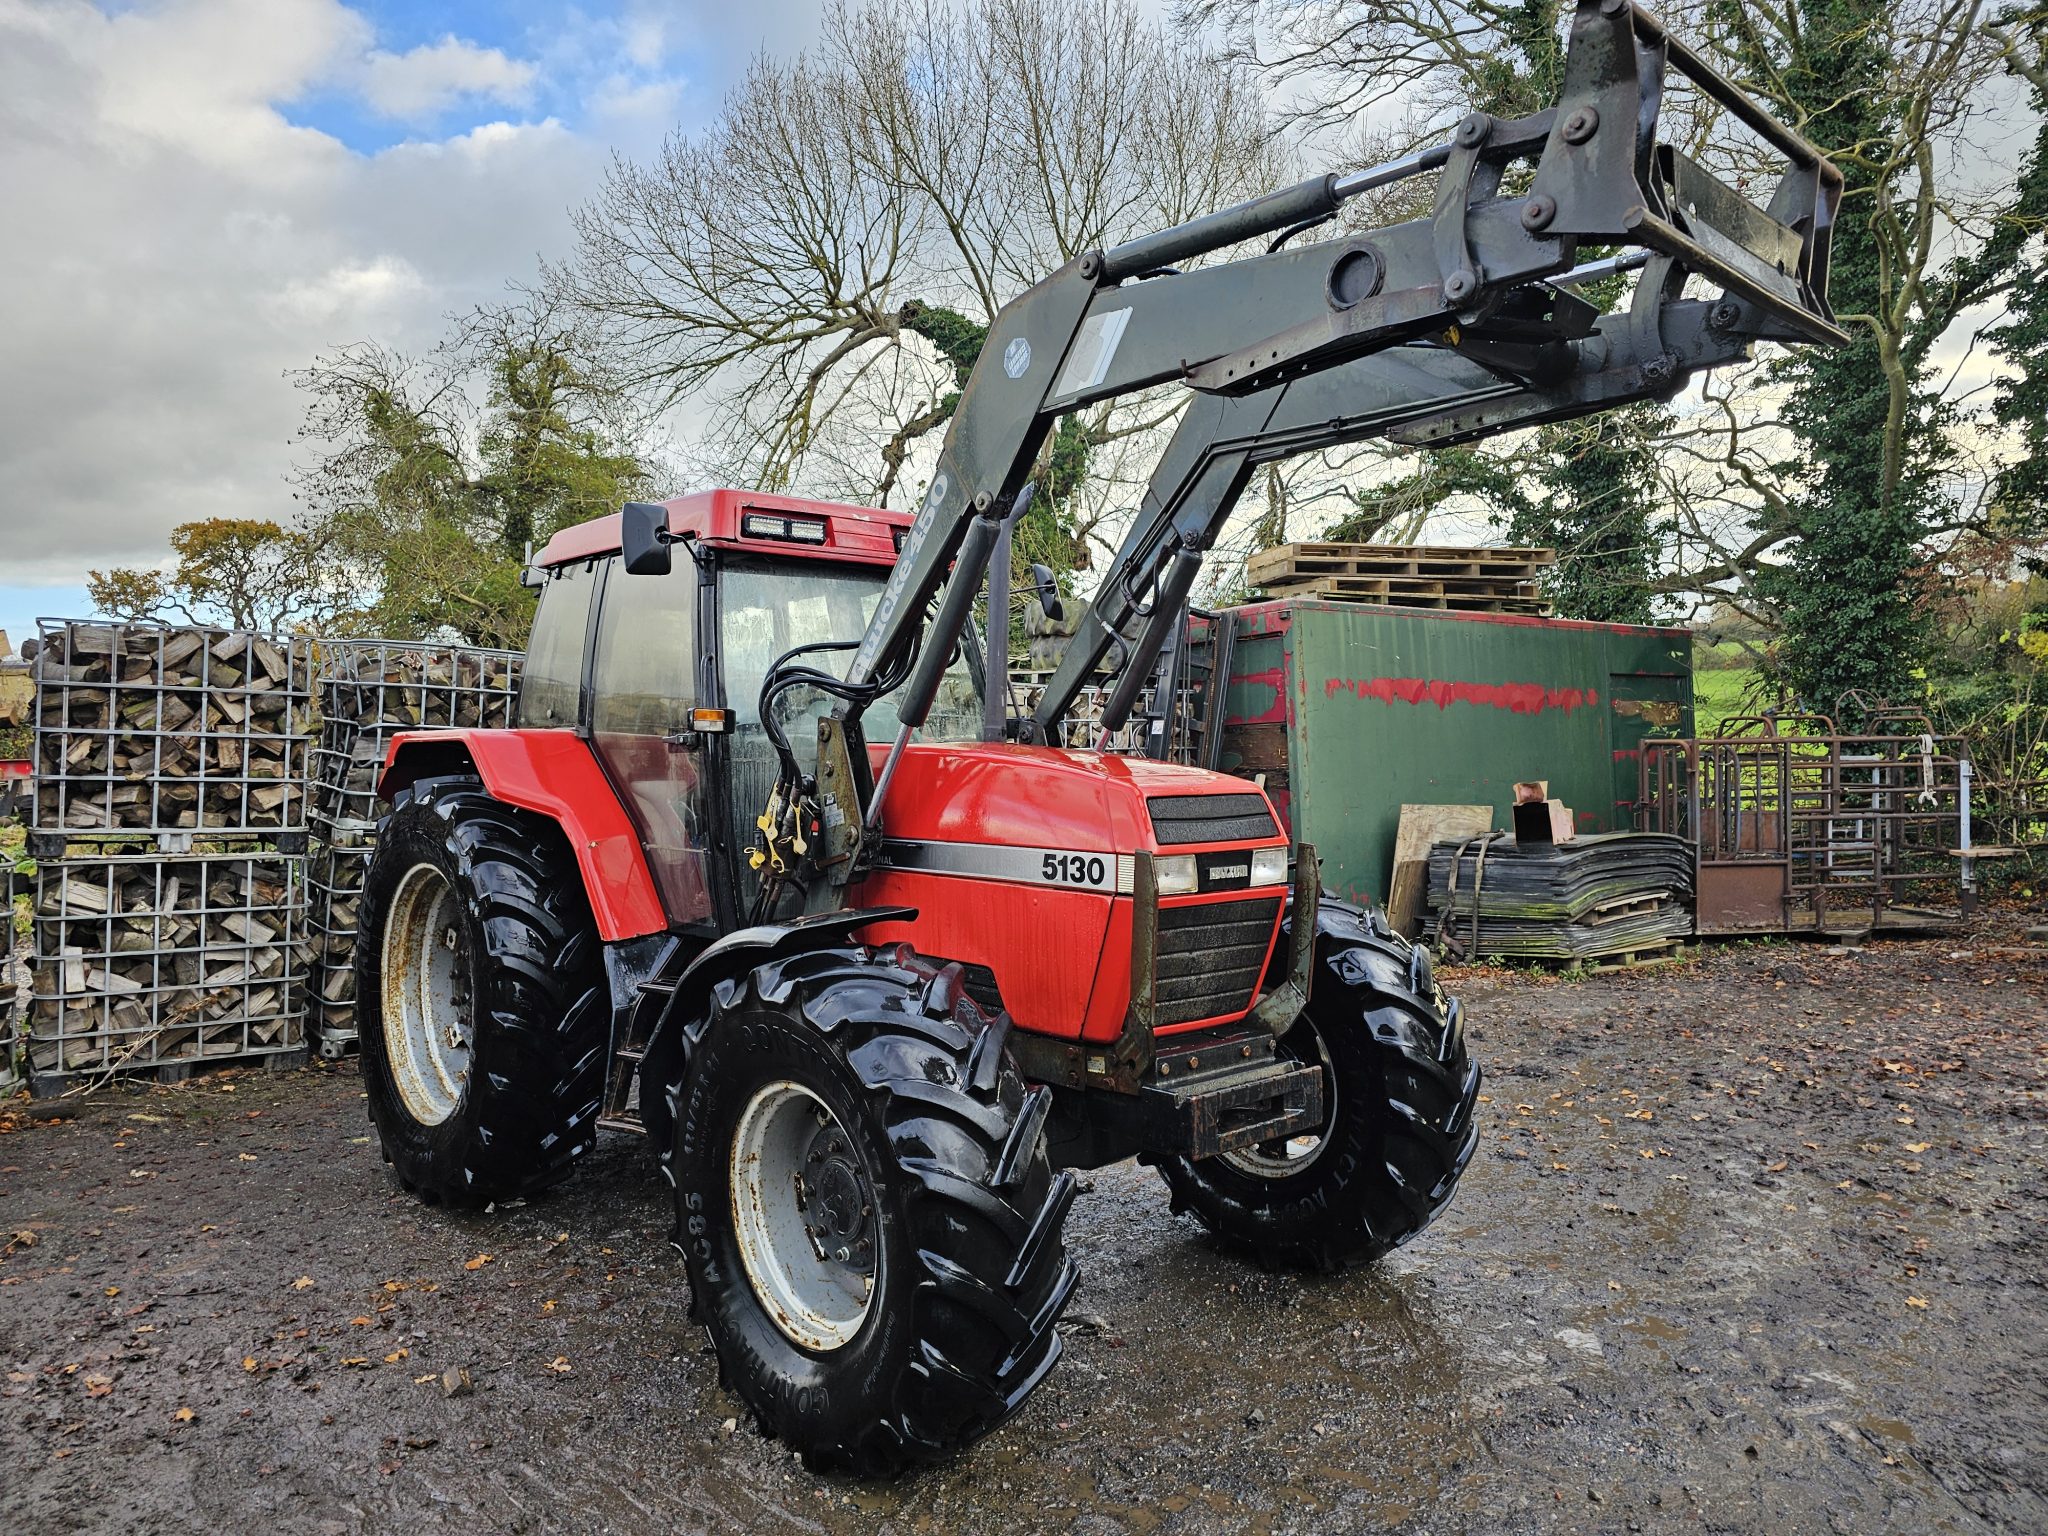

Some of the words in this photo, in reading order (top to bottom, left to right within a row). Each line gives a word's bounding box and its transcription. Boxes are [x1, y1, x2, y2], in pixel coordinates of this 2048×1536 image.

[849, 559, 912, 684] Quicke
[909, 474, 948, 556] 450
[877, 855, 894, 865] NAL
[1042, 854, 1105, 885] 5130
[684, 1192, 721, 1283] AC85
